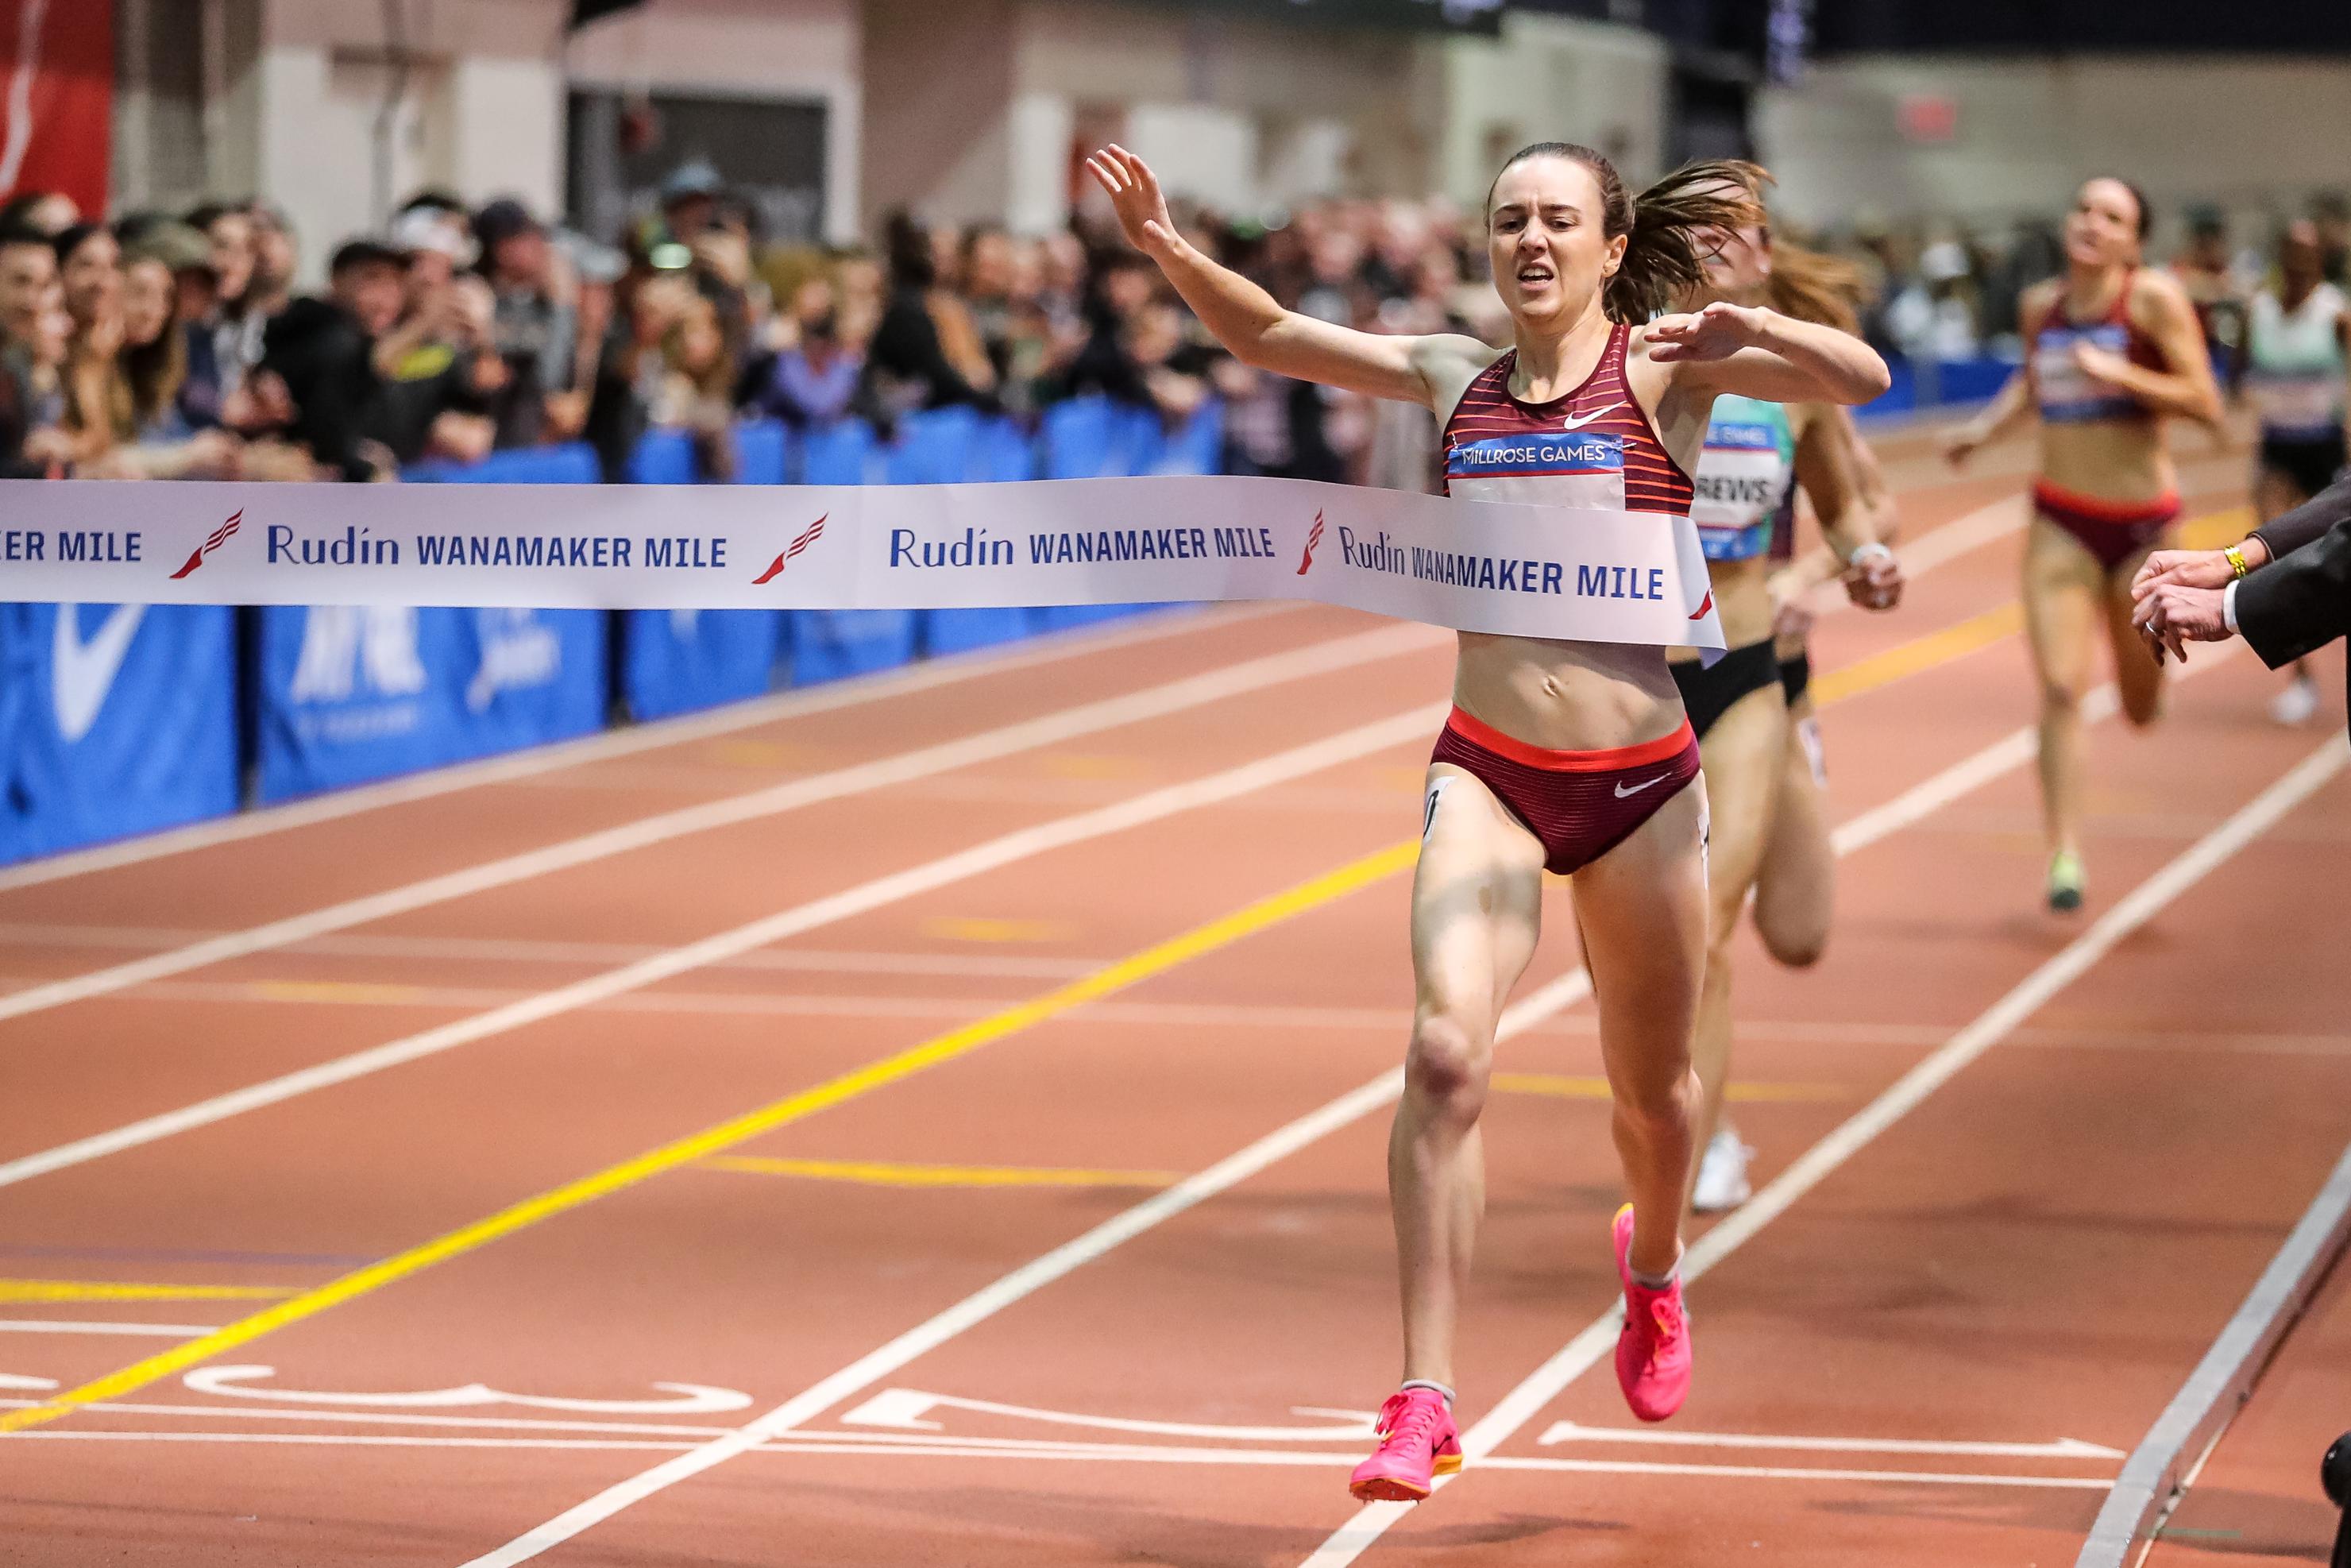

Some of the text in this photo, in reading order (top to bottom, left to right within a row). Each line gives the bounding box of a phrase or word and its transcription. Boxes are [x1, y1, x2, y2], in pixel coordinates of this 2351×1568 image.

[1462, 445, 1607, 465] MILLROSE GAMES
[0, 531, 141, 562] ER MILE
[417, 535, 631, 567] WANAMAKER
[644, 538, 727, 568] MILE
[1029, 528, 1207, 565] WANAMAKER
[1214, 527, 1276, 558] MILE
[1411, 545, 1562, 595] WANAMAKER
[1577, 564, 1664, 601] MILE
